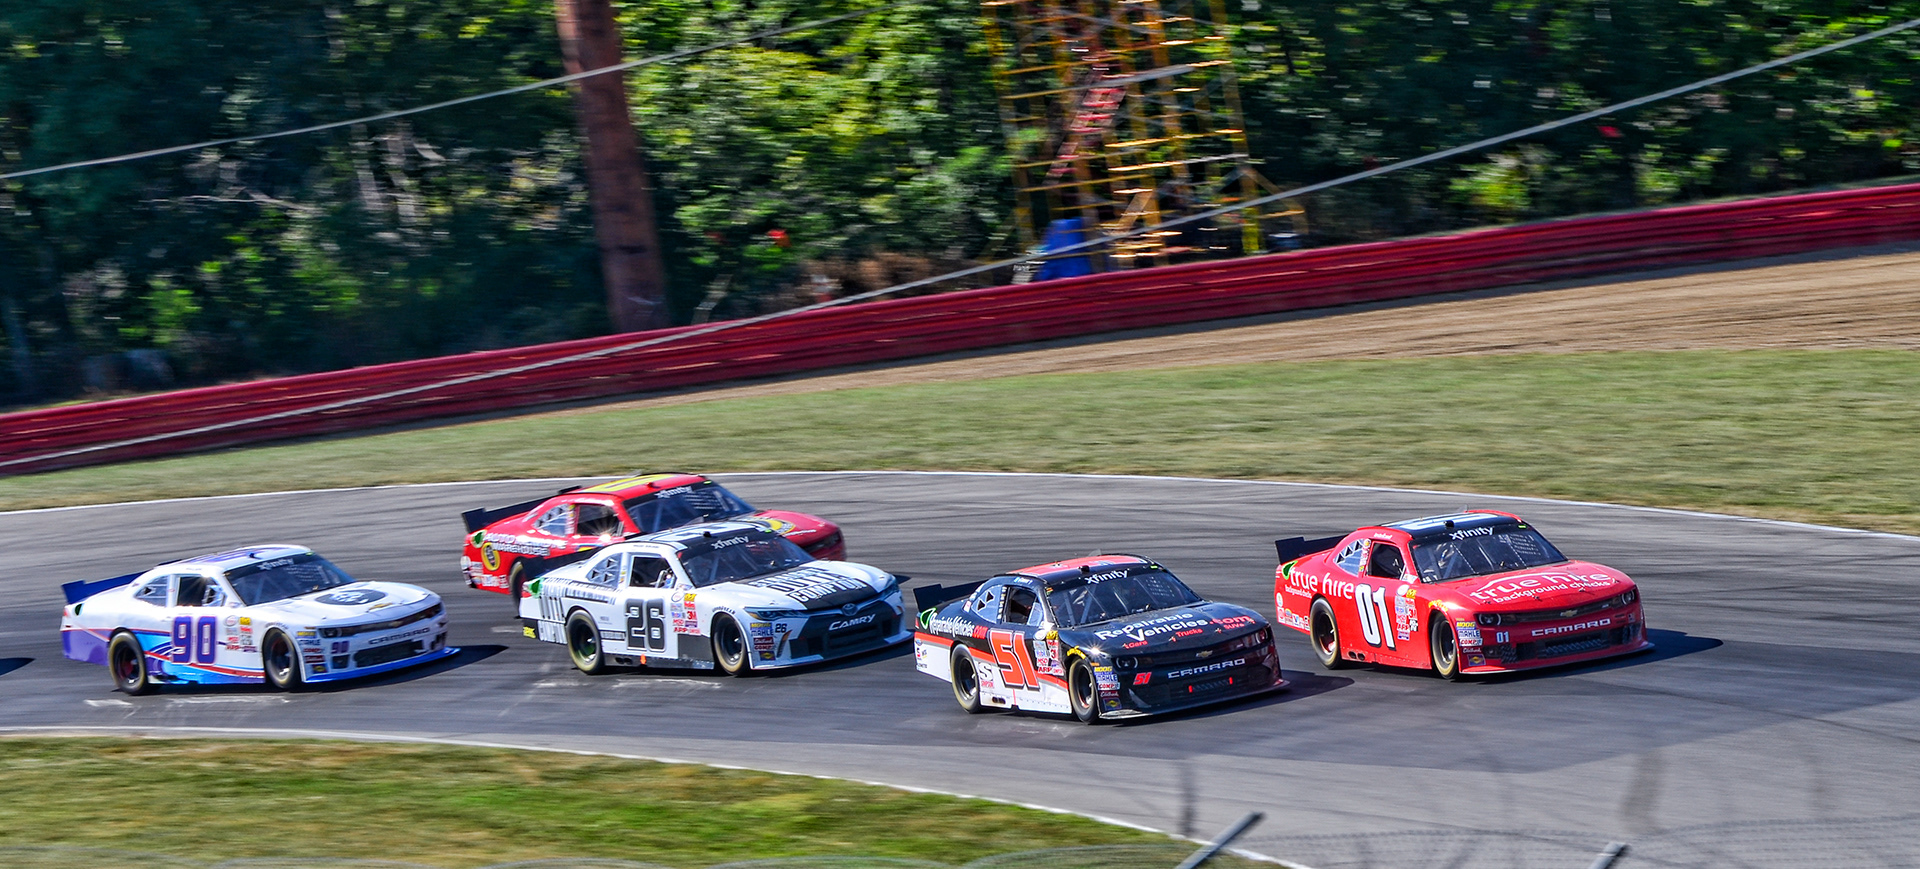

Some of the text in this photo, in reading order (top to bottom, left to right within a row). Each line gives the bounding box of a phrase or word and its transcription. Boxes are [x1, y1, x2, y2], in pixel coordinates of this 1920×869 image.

[1448, 526, 1495, 541] xfinity
[711, 536, 750, 550] xfinity
[1084, 568, 1129, 585] xfinity
[1289, 567, 1354, 599] true hire
[787, 577, 867, 602] COMPTON
[1469, 572, 1612, 600] true hire
[1493, 583, 1568, 603] background
[625, 598, 666, 651] 26
[828, 613, 876, 631] CAMRY
[1094, 612, 1194, 641] Repairable
[1223, 622, 1246, 630] SUVs
[1354, 583, 1397, 652] 01
[368, 627, 430, 645] CAMARO
[775, 623, 788, 634] 26
[1126, 615, 1252, 642] Vehicles.com
[1175, 628, 1203, 638] Trucks
[1458, 629, 1481, 638] MAHLE
[1531, 618, 1611, 637] CAMARO
[172, 616, 217, 664] 90
[1128, 640, 1148, 648] Cars
[1495, 631, 1510, 643] 01
[331, 640, 350, 654] 90
[986, 628, 1041, 691] 51
[1167, 658, 1246, 679] CAMARO
[1096, 674, 1118, 682] MAHLE
[1133, 672, 1152, 685] 51
